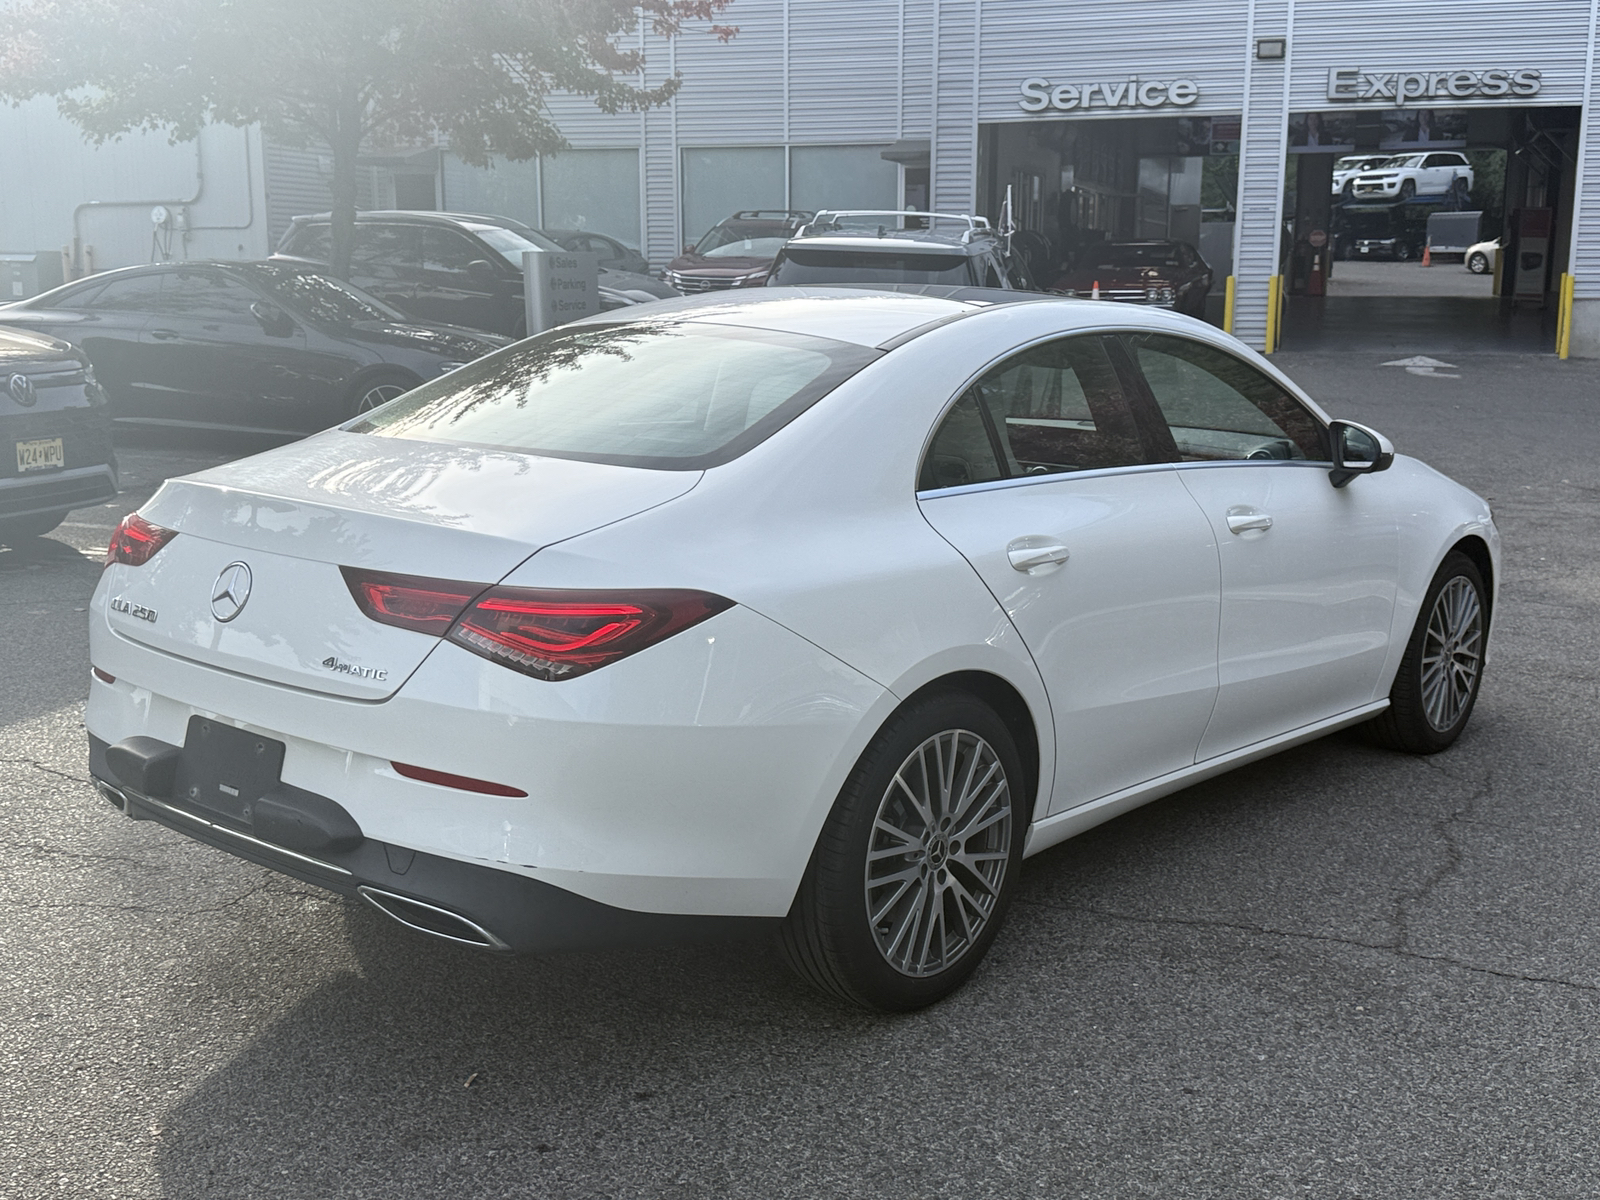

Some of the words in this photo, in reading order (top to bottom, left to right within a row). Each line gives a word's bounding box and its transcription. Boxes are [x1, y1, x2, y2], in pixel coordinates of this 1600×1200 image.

[1018, 75, 1198, 112] Service
[1327, 66, 1542, 106] Express
[556, 256, 577, 268] Sales
[557, 279, 586, 291] Parking
[559, 300, 586, 311] Service
[132, 604, 158, 623] 250
[322, 656, 388, 681] 4MATIC
